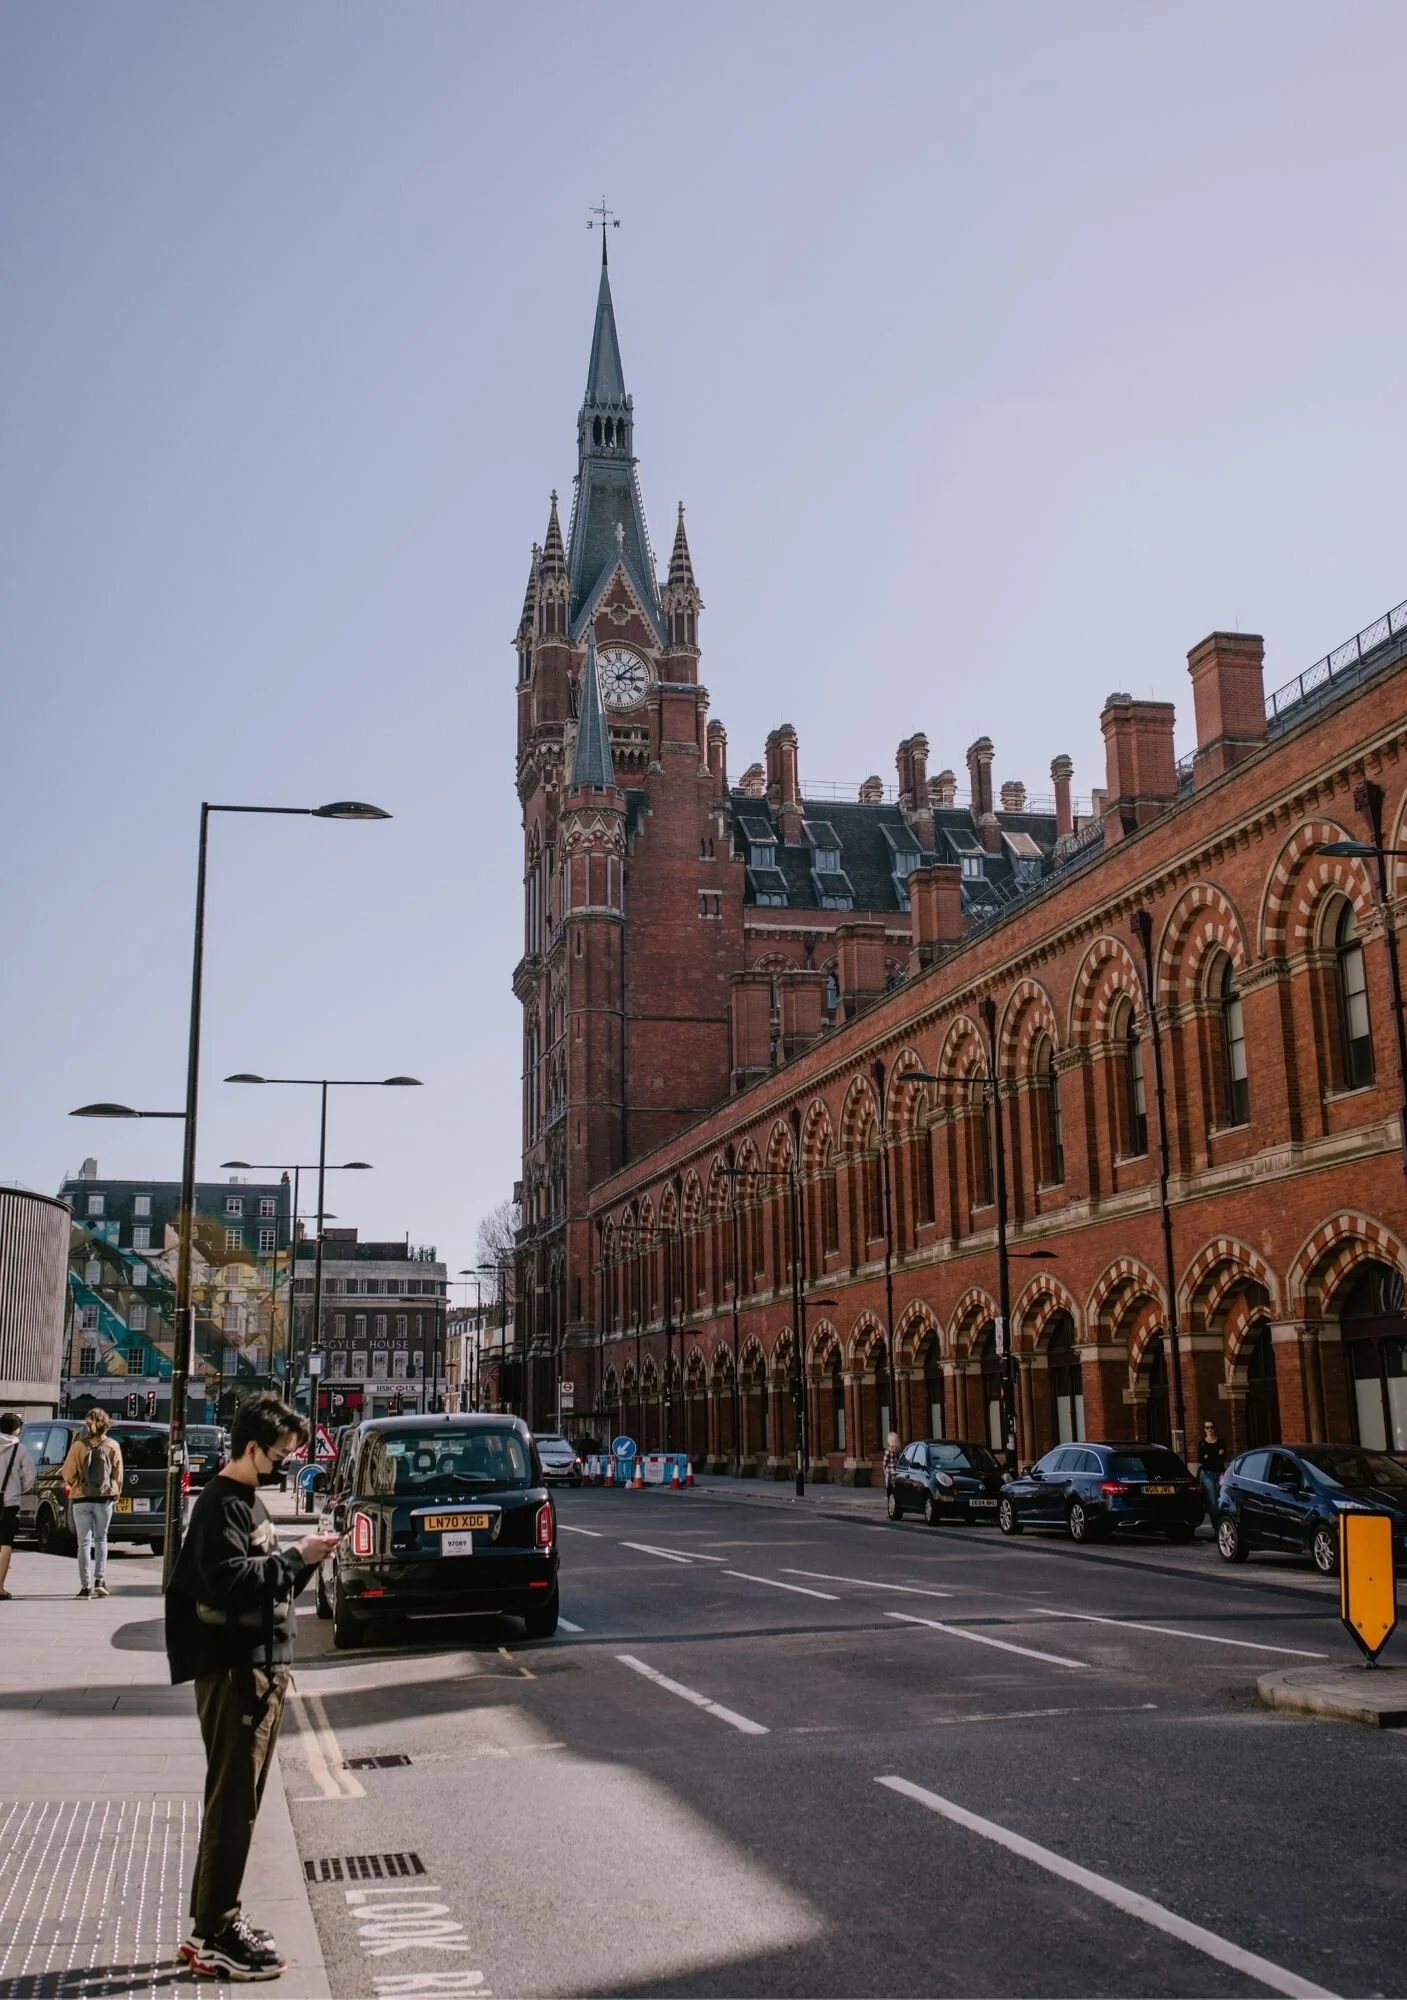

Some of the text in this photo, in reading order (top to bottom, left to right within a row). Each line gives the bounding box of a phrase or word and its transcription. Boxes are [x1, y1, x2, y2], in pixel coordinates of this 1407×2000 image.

[369, 1340, 409, 1350] HOUSE
[376, 1384, 396, 1392] HSBC
[405, 1384, 416, 1392] UK
[428, 1515, 484, 1529] LN70 XDG
[344, 1886, 472, 1957] LOOK
